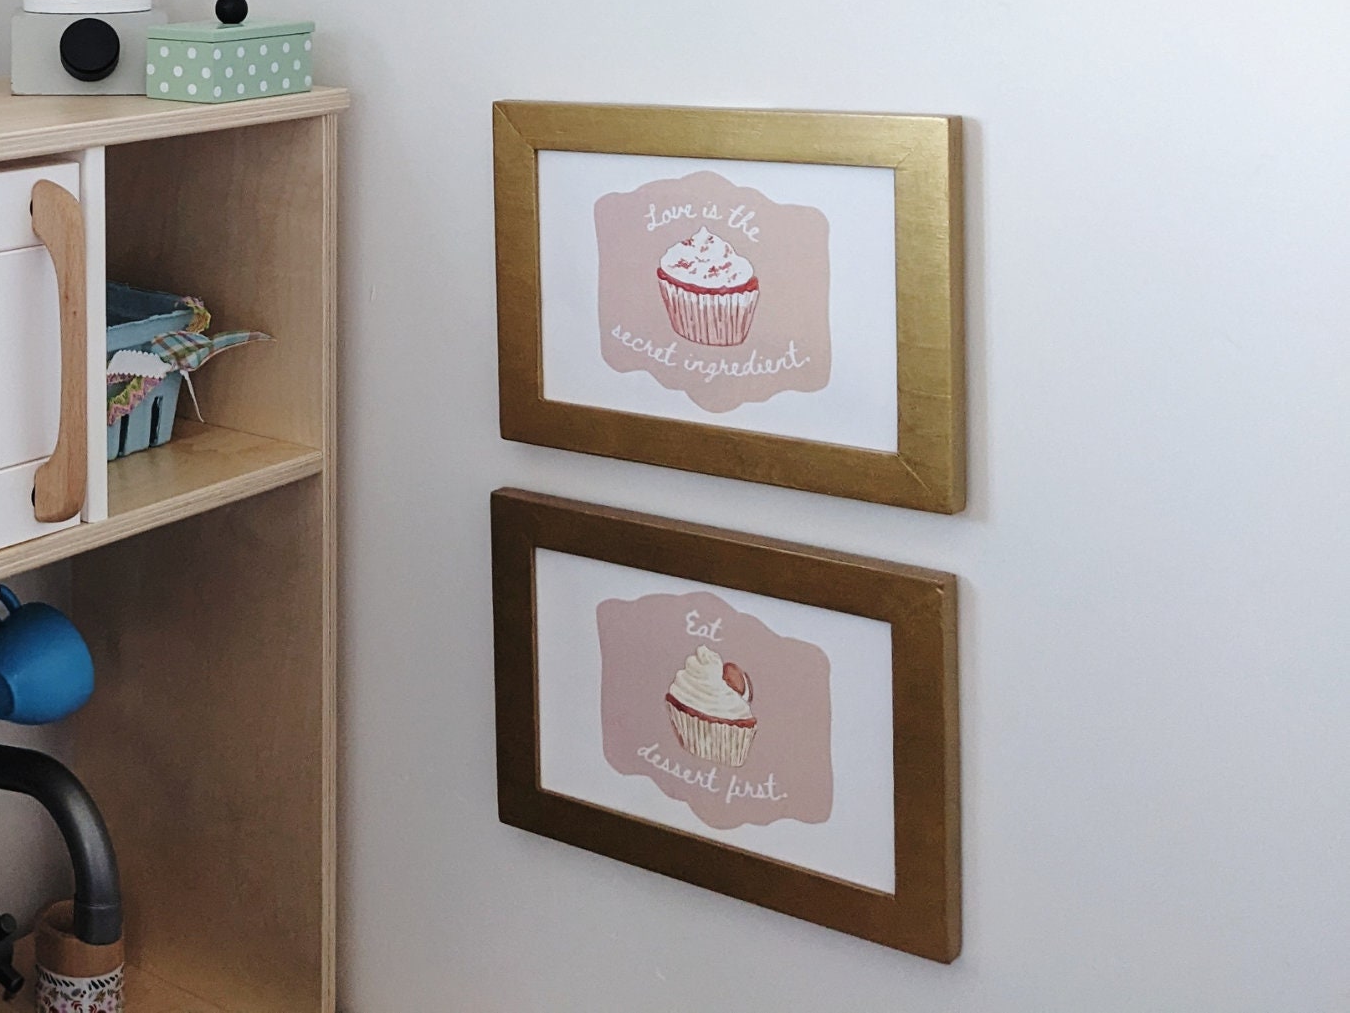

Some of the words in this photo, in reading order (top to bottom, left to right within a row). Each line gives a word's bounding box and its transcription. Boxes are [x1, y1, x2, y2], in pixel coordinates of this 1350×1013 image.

[644, 203, 697, 231] Love
[702, 201, 722, 221] is
[728, 204, 760, 243] the
[611, 324, 676, 366] secret
[683, 340, 811, 383] ingredient.
[685, 609, 723, 642] Eat
[637, 743, 720, 792] dessert
[726, 773, 788, 804] first.
